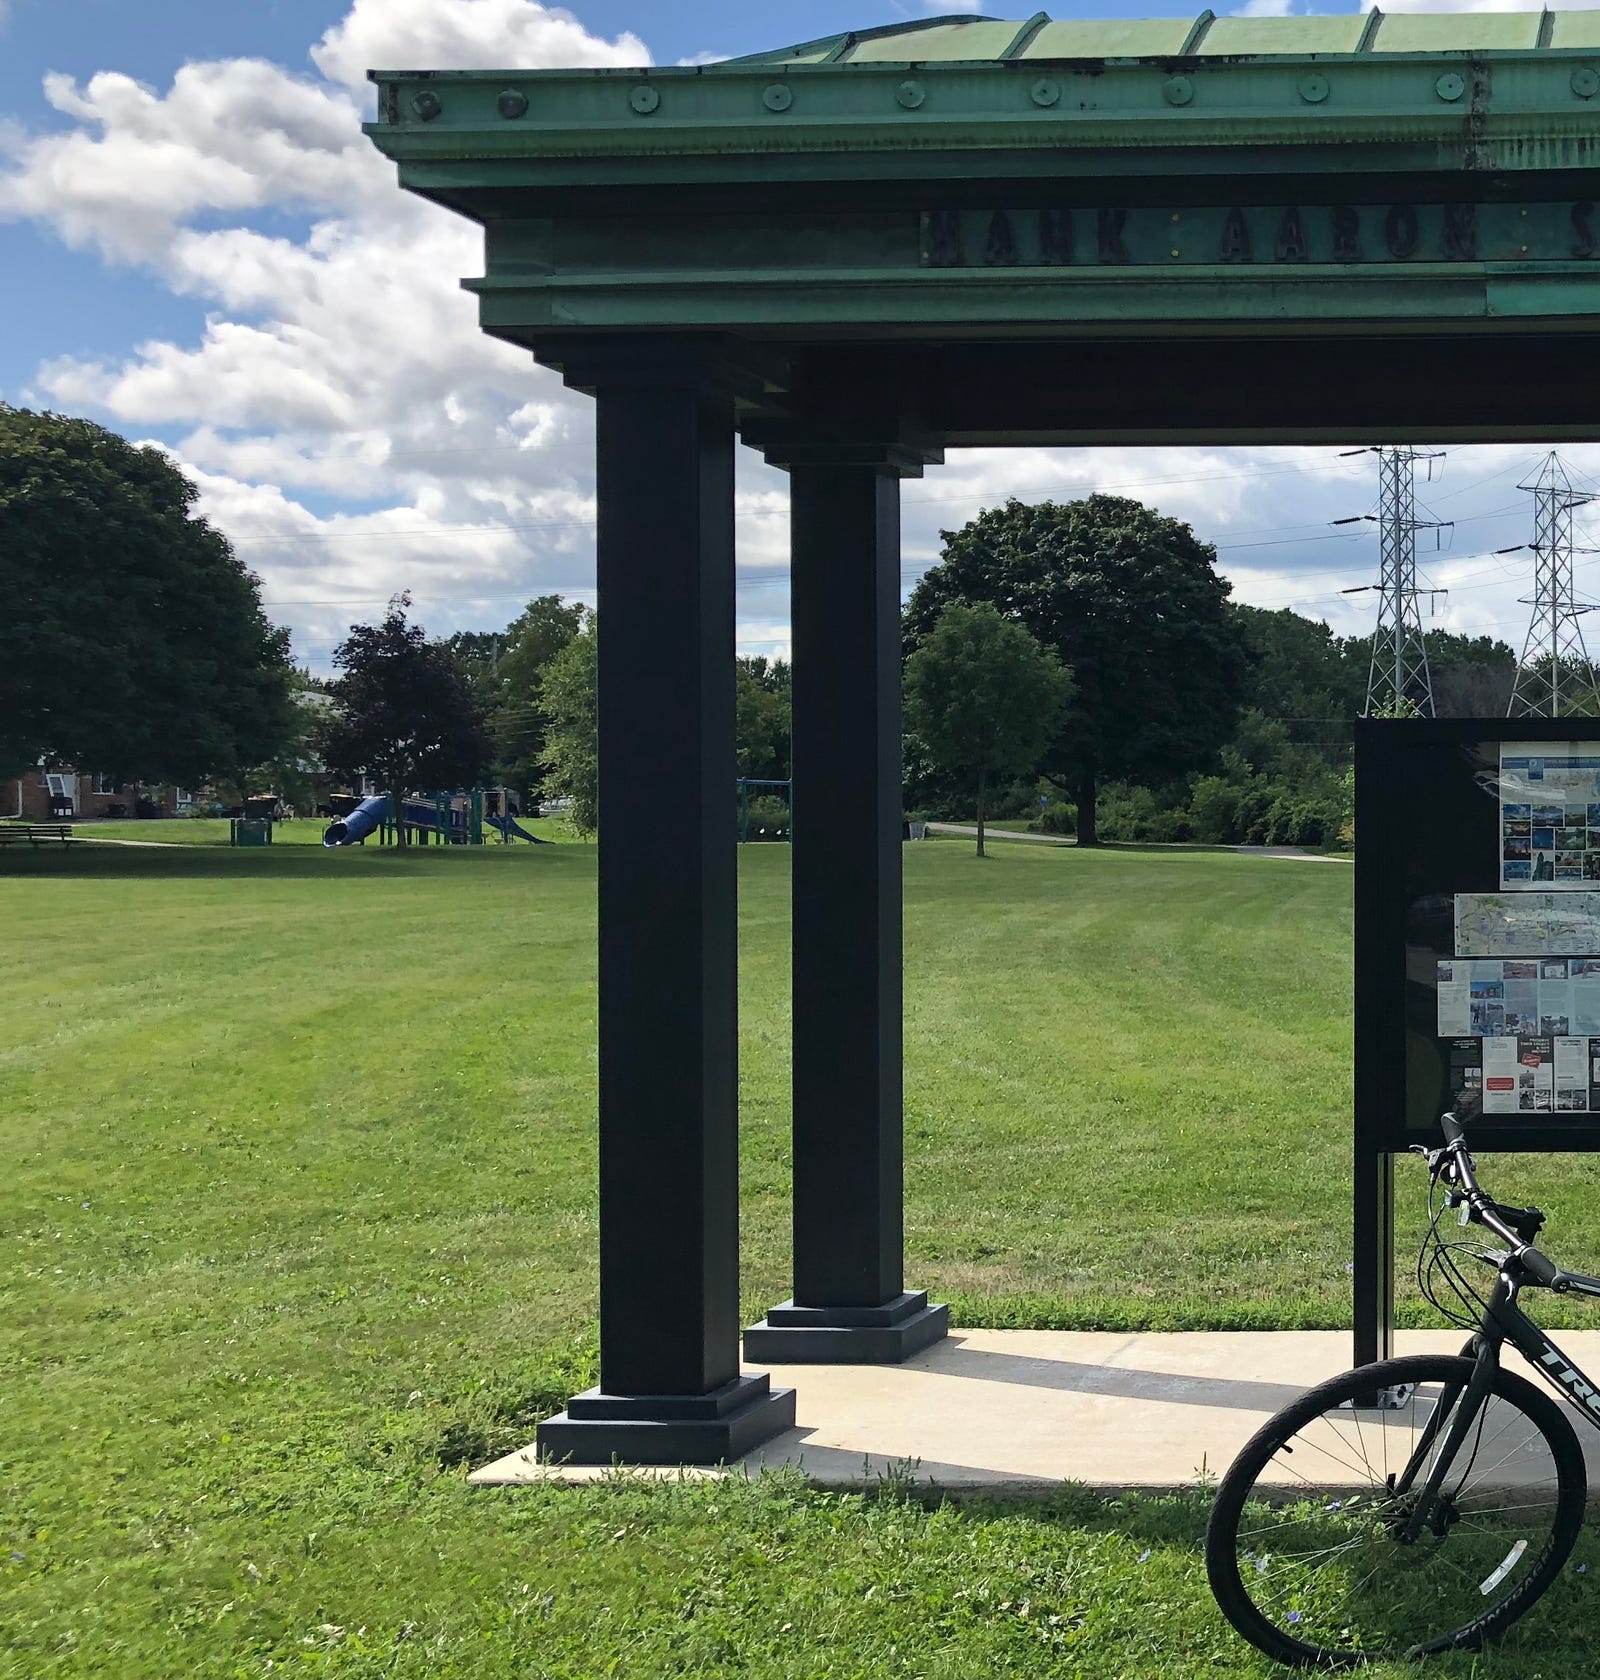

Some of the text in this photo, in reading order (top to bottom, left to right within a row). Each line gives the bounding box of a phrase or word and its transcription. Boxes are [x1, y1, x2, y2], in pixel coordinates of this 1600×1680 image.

[929, 208, 1129, 266] HANK
[1219, 204, 1477, 263] AARON
[1455, 1533, 1556, 1642] BONTRAGER
